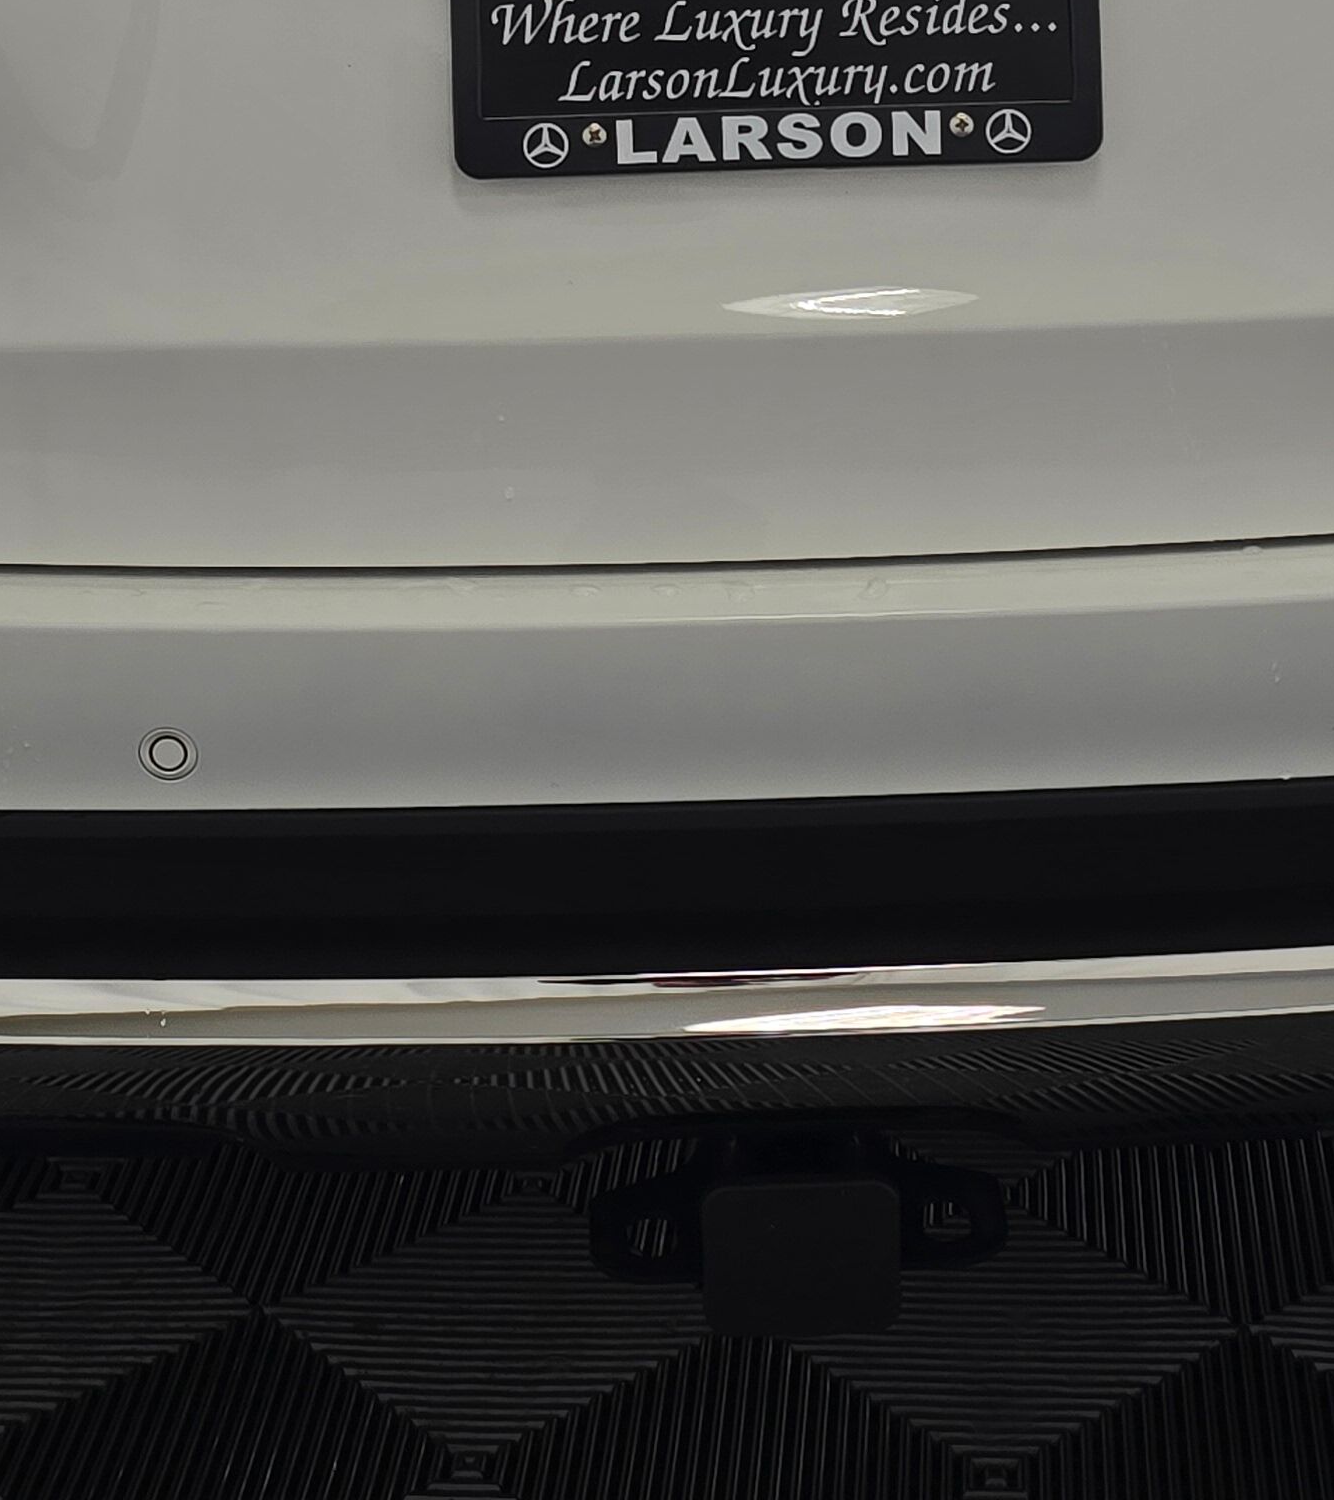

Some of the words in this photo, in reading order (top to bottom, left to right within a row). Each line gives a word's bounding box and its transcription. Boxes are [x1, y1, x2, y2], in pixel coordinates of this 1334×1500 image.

[654, 0, 823, 57] Luxury
[558, 56, 996, 106] LarsonLuxury.com
[615, 109, 942, 165] LARSON
